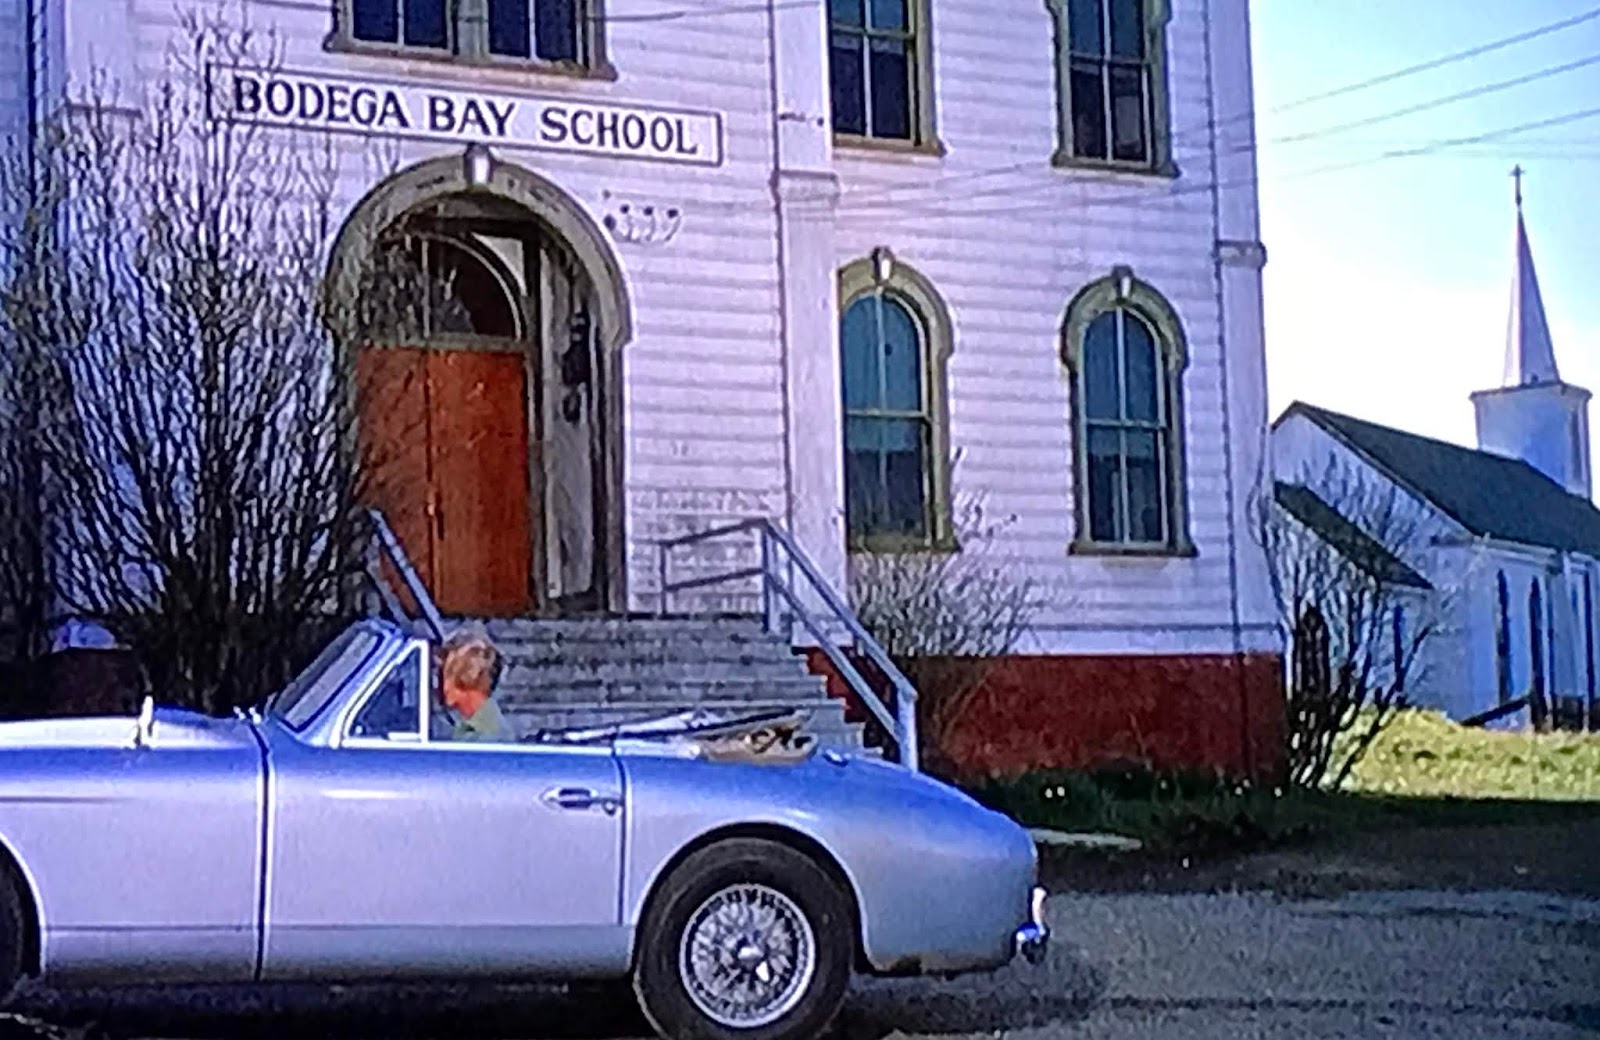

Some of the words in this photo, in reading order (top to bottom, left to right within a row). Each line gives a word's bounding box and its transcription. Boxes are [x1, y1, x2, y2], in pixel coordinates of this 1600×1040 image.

[234, 76, 410, 128] BODEGA
[428, 95, 515, 137] BAY
[540, 106, 698, 154] SCHOOL
